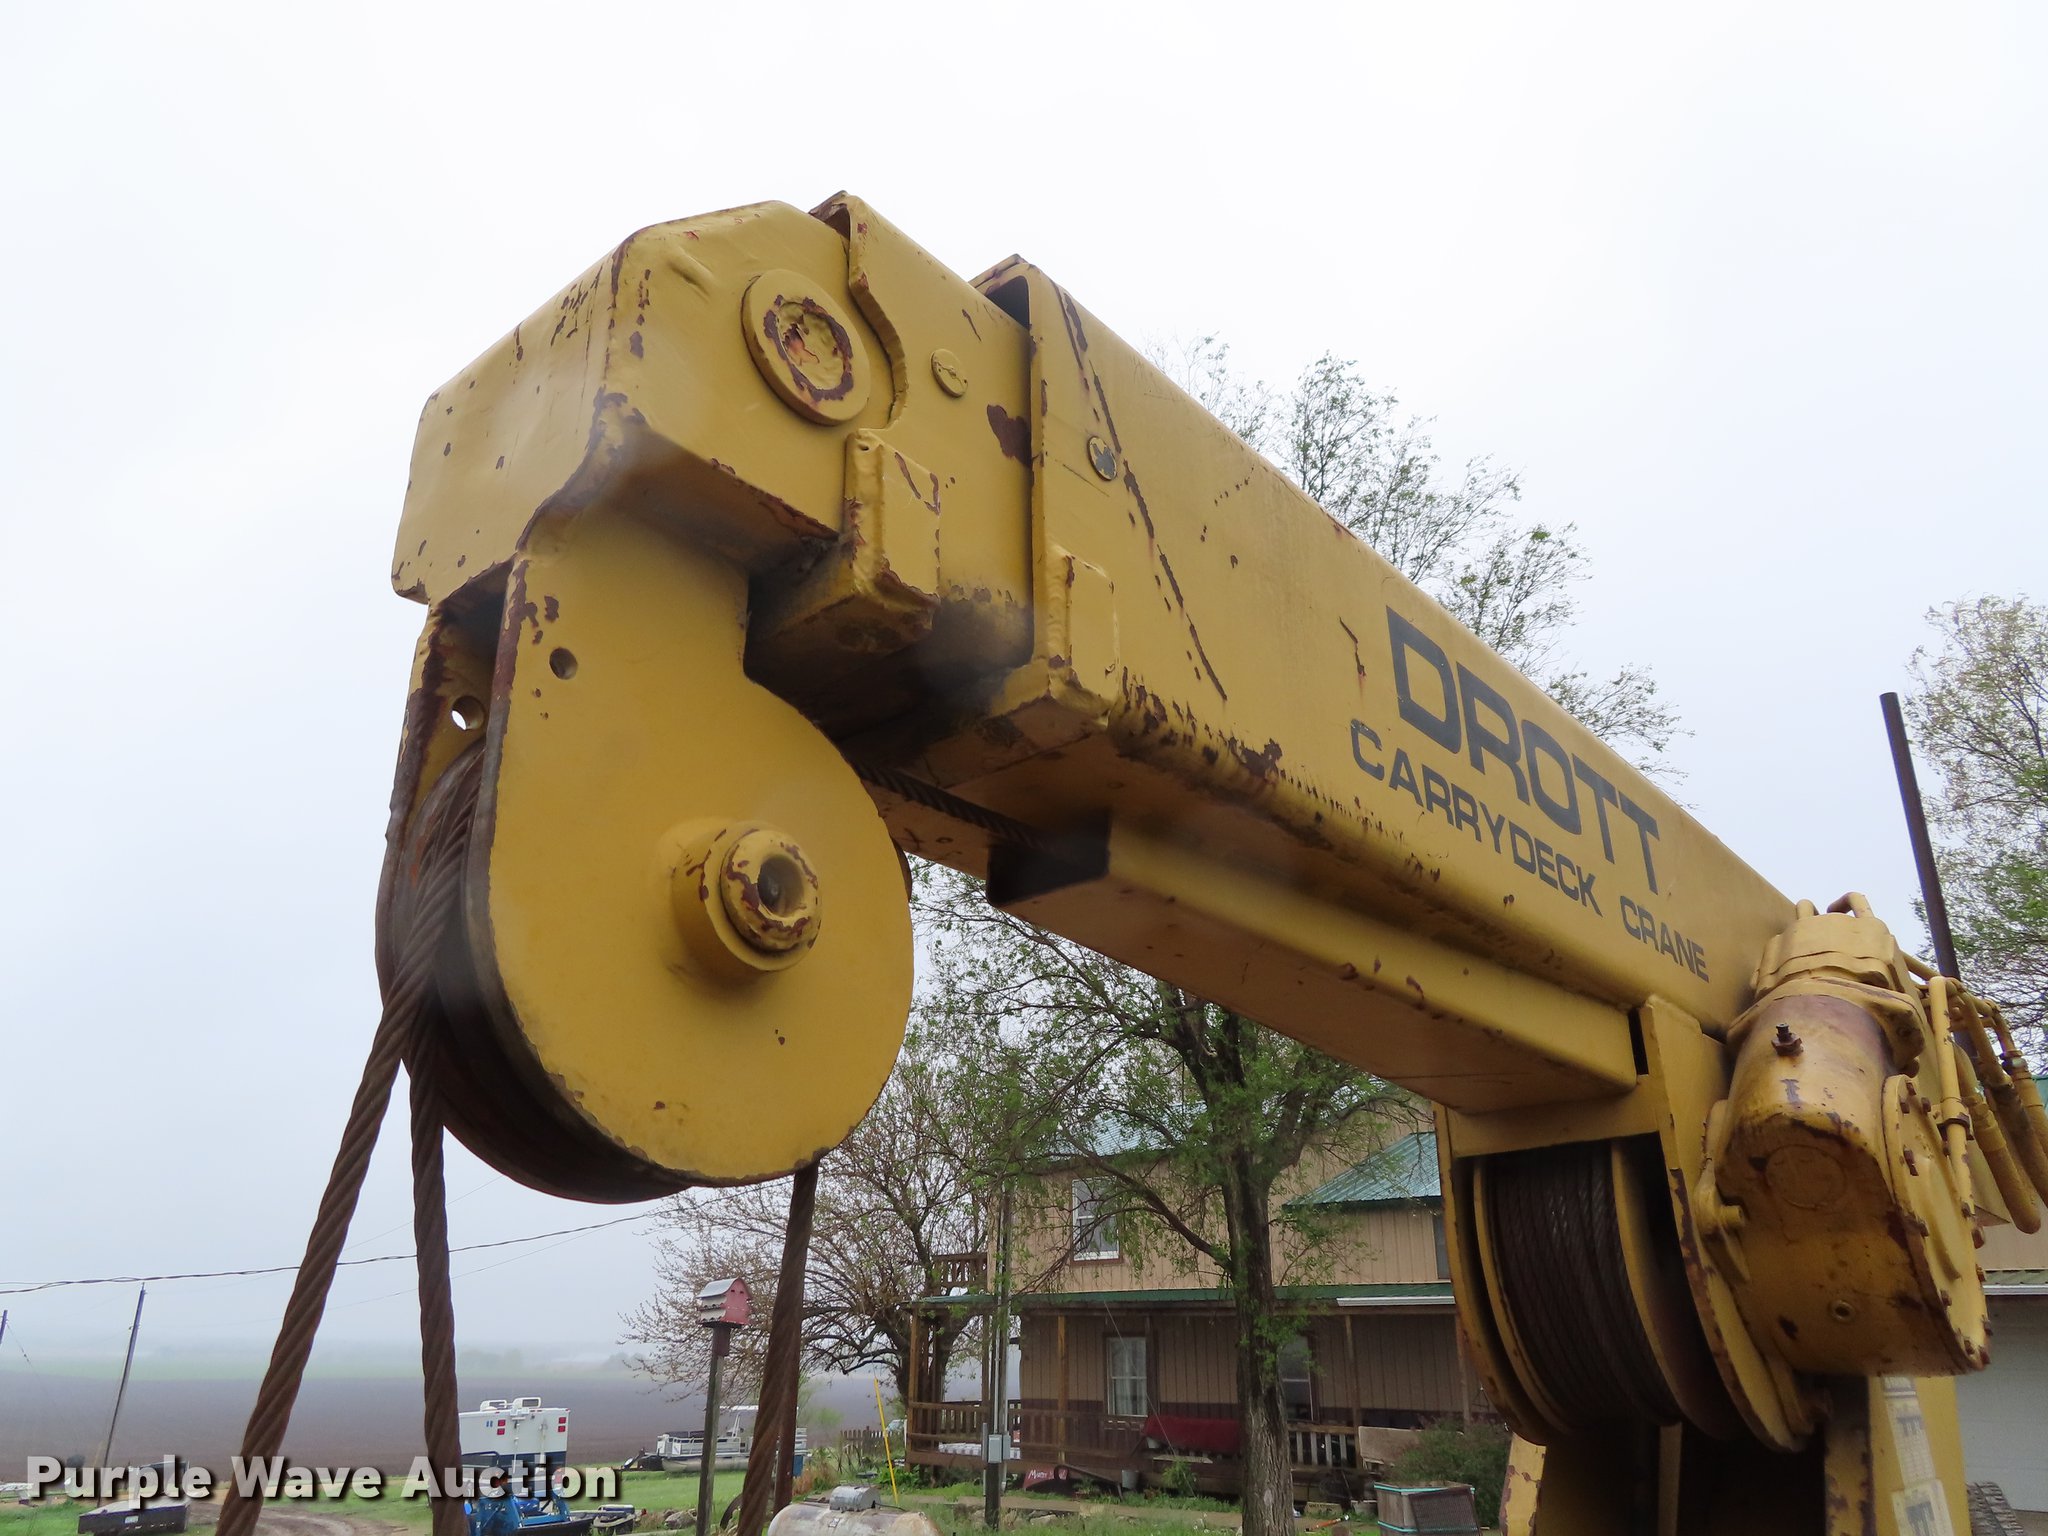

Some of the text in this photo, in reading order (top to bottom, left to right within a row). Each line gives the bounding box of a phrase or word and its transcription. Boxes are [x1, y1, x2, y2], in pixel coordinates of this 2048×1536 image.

[1350, 719, 1710, 983] CARRYDECK CRANE
[1386, 605, 1660, 895] DROTT
